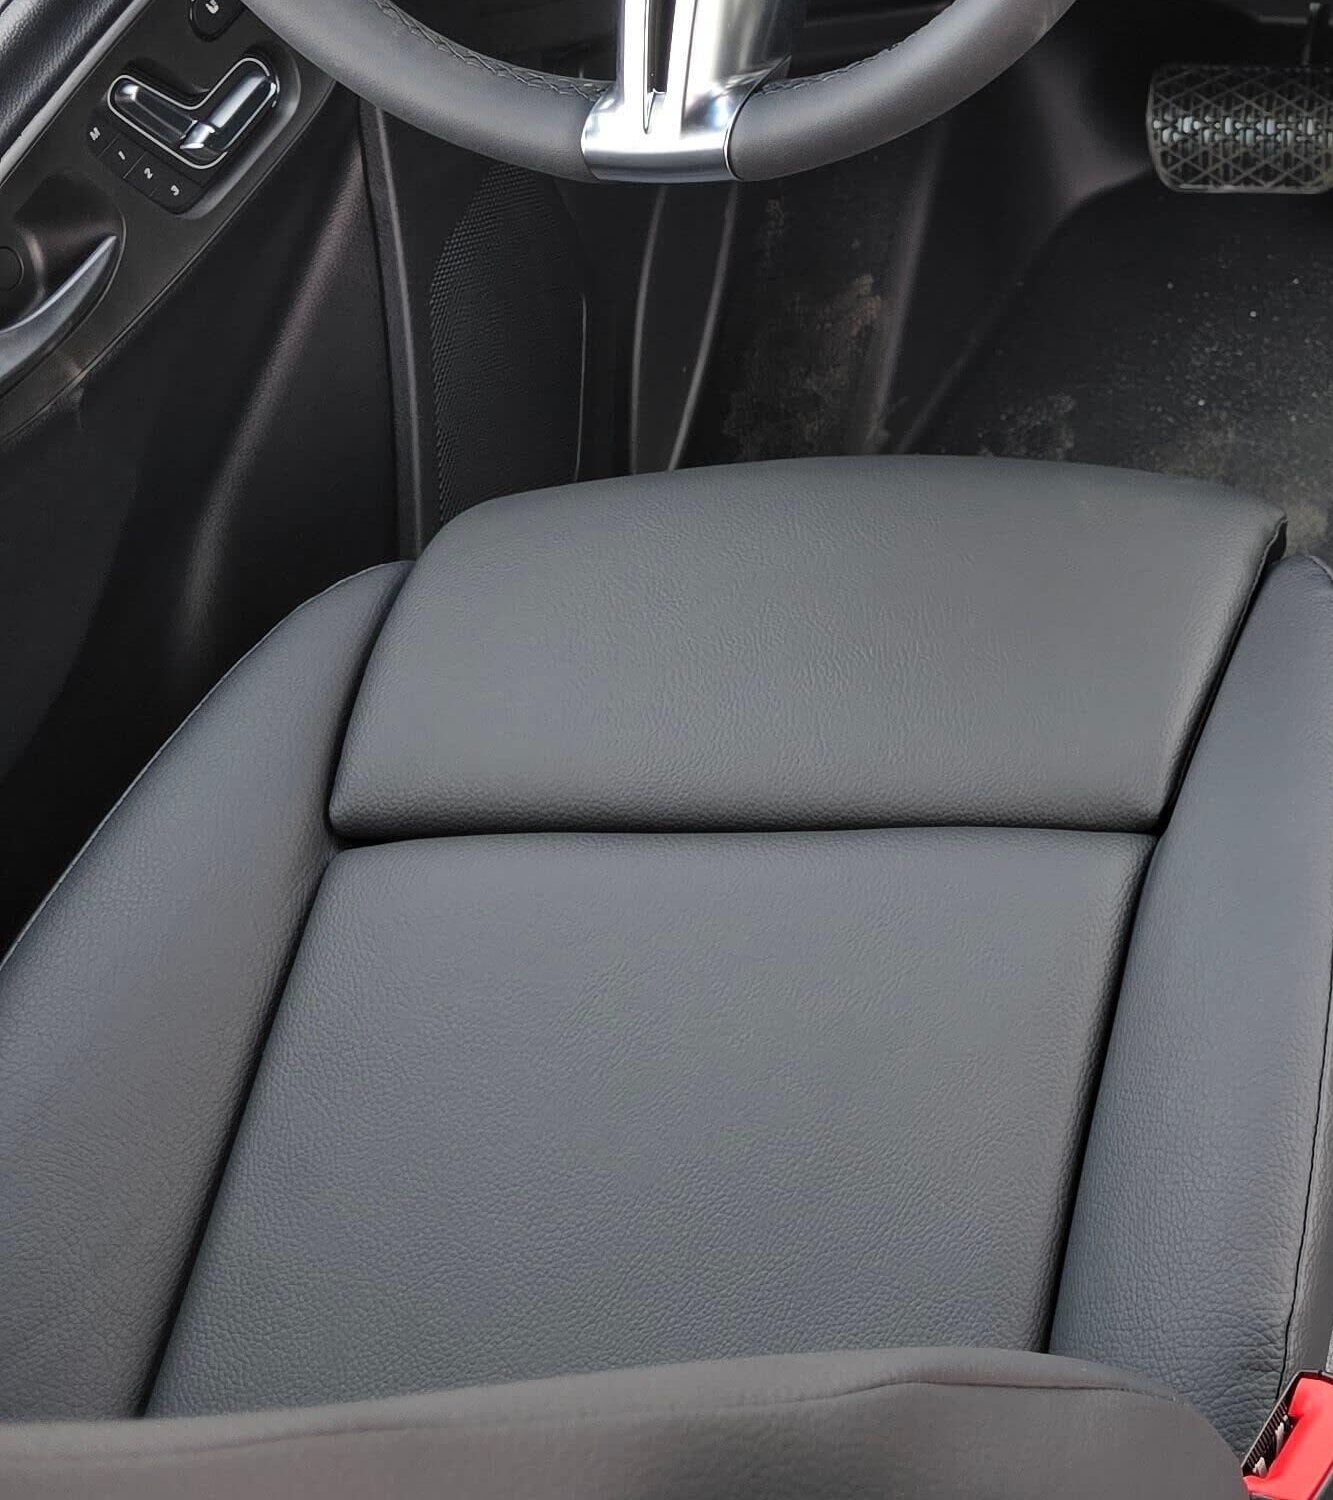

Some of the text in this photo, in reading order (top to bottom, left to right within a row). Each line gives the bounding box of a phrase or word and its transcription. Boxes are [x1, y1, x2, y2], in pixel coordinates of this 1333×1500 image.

[90, 127, 100, 141] M
[118, 151, 125, 160] 1
[144, 168, 153, 179] 2
[171, 185, 179, 196] 3
